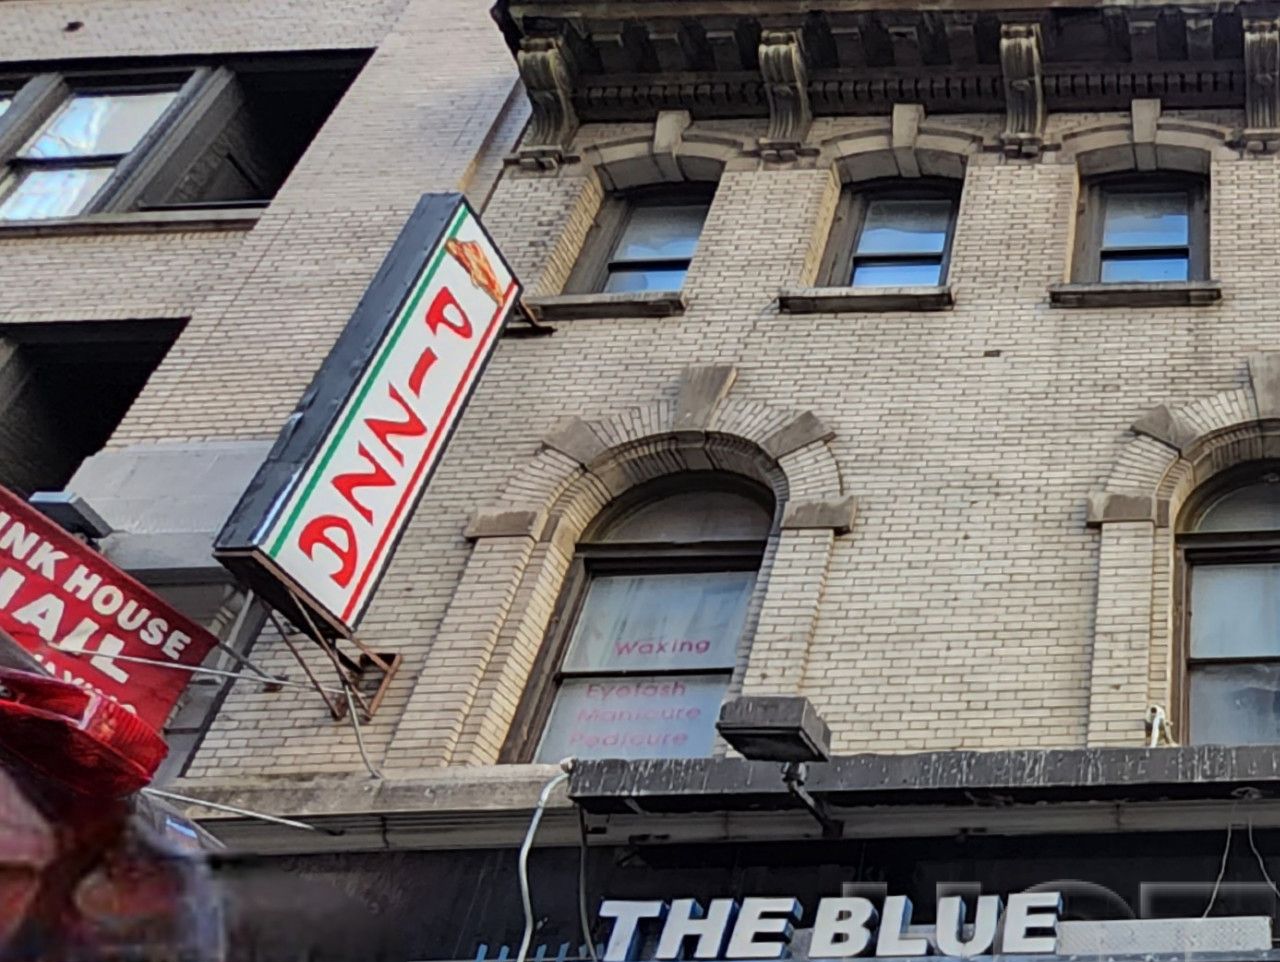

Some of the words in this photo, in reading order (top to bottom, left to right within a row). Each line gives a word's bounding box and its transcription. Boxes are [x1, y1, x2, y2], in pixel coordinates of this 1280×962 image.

[62, 563, 192, 661] HOUSE
[614, 640, 711, 656] Waxing
[576, 707, 701, 723] Manicure
[569, 732, 689, 747] Pedicure
[598, 897, 801, 962] THE
[807, 892, 1062, 958] BLUE
